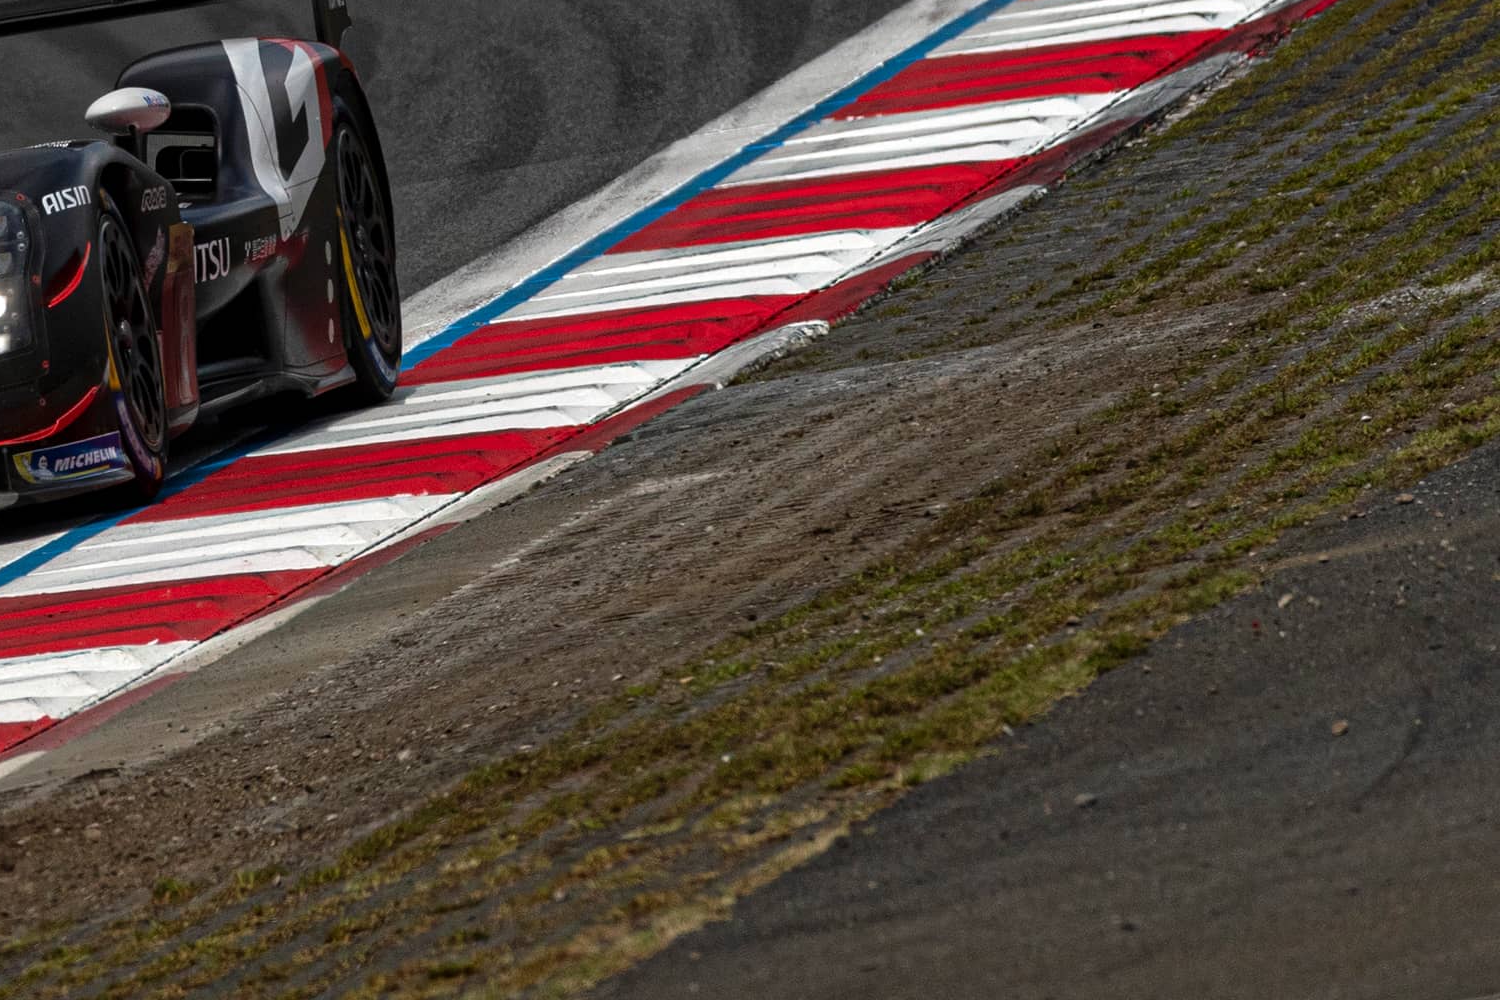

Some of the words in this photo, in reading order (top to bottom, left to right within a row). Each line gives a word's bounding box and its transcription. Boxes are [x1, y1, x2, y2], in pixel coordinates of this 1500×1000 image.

[42, 184, 92, 215] AISIN
[193, 237, 230, 284] ITSU
[54, 446, 117, 472] MICHELIN
